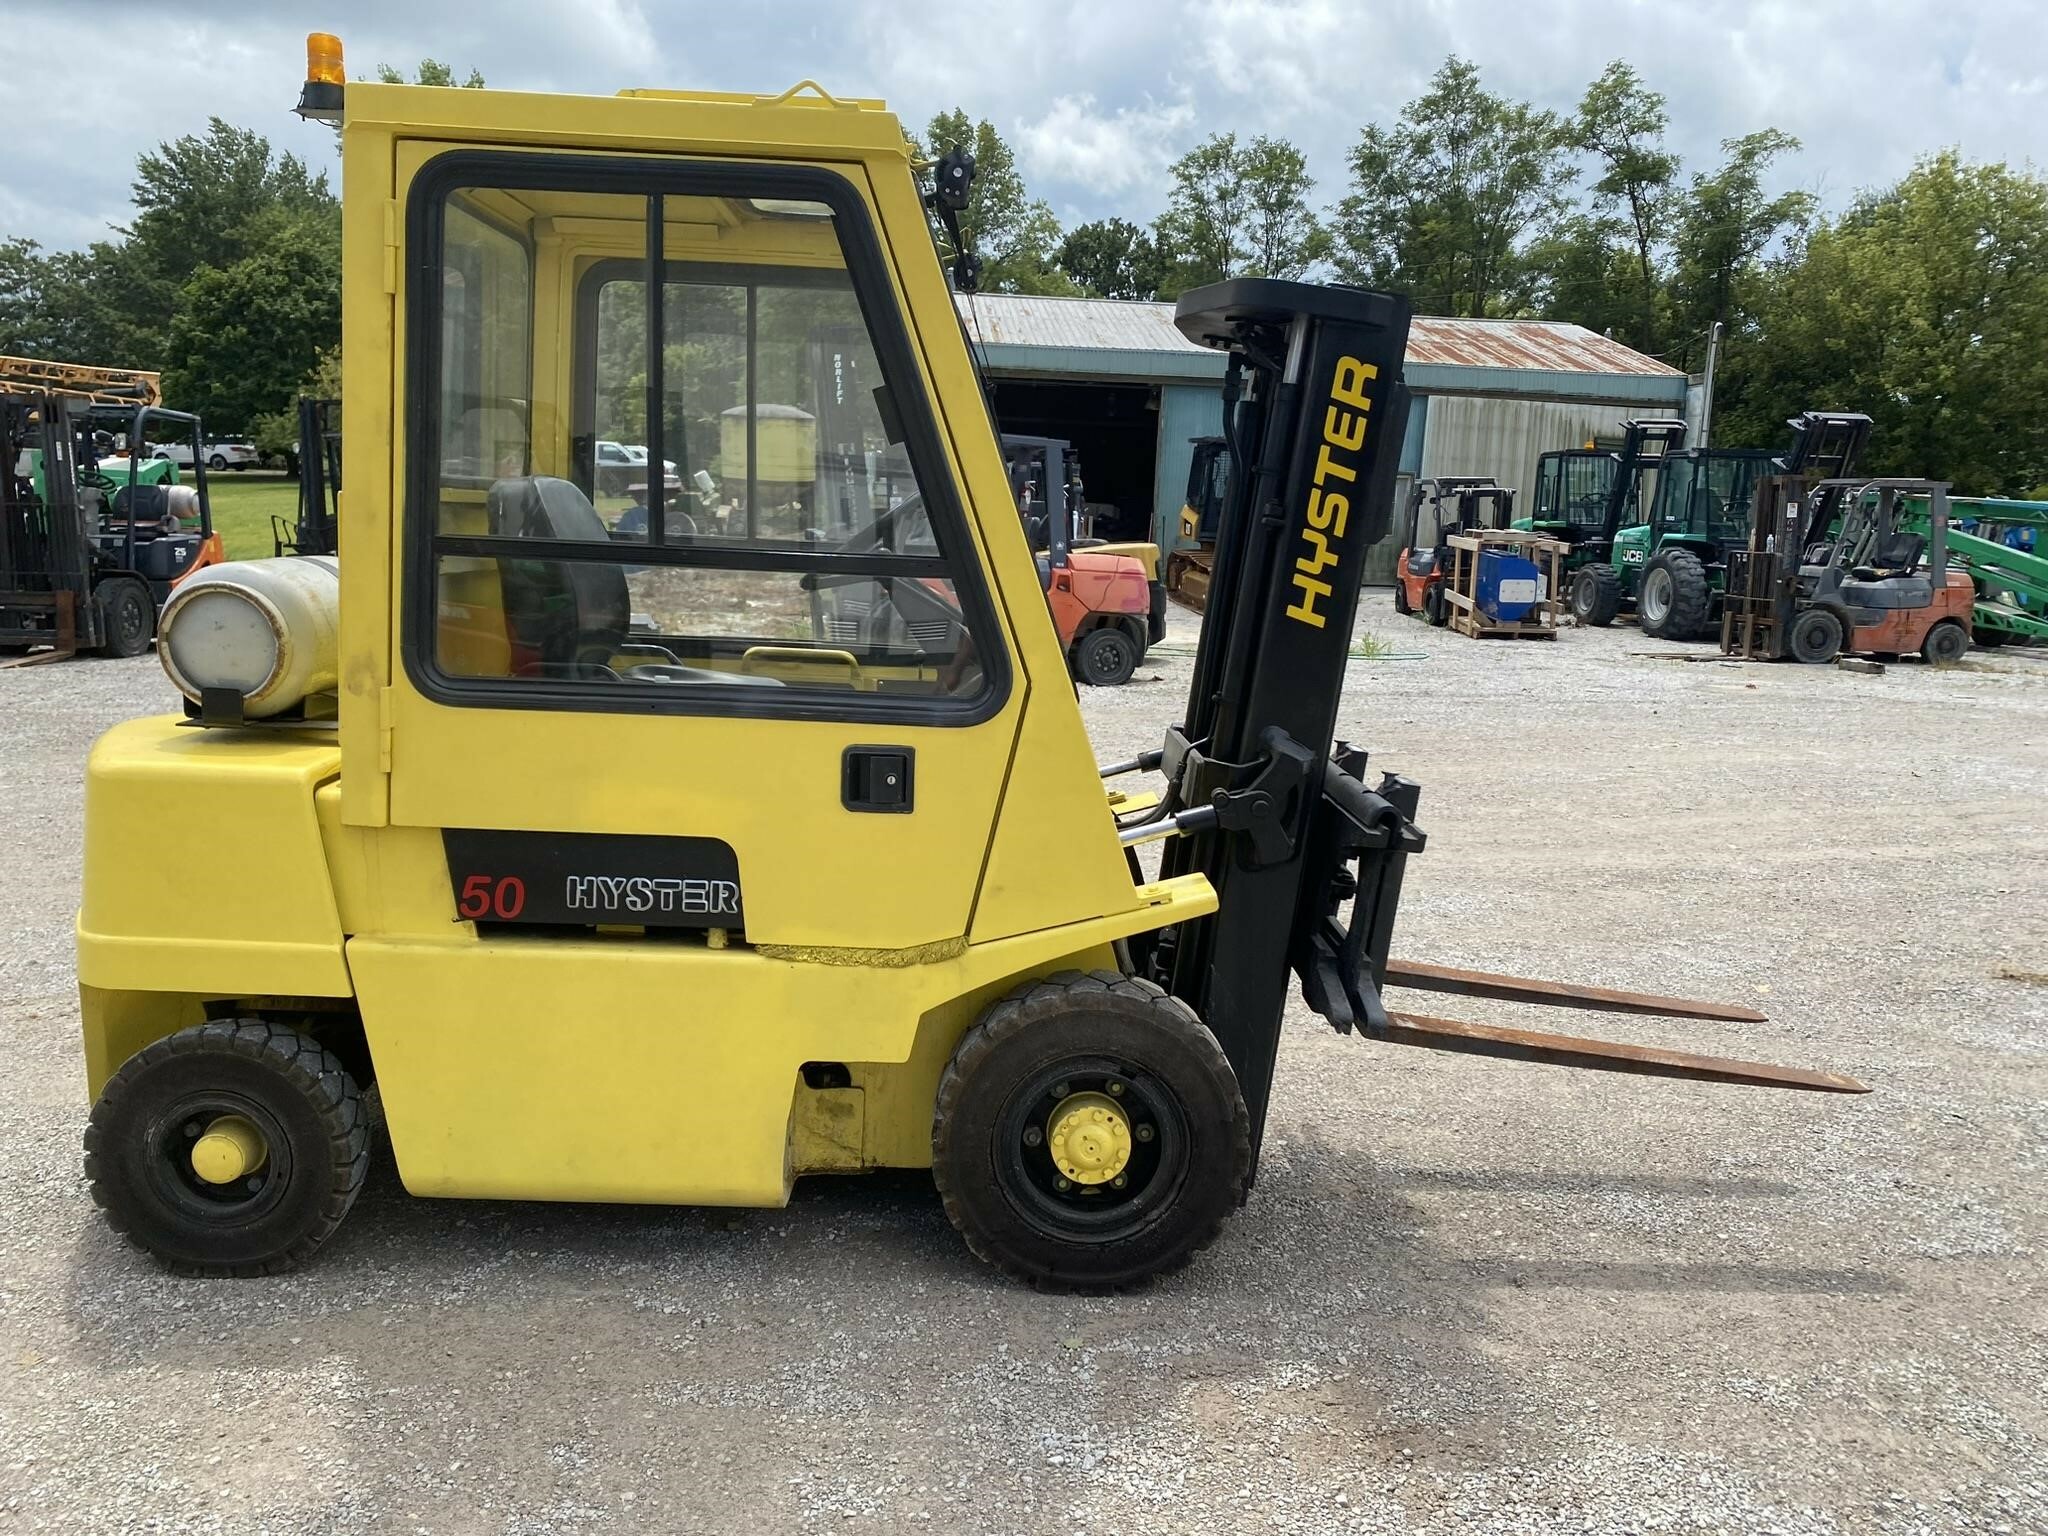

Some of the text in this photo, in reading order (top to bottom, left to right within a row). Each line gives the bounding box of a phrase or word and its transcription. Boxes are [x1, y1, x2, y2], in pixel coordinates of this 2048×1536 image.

[1286, 355, 1379, 629] HYSTER
[1622, 549, 1644, 563] JCB
[460, 875, 525, 919] 50
[567, 876, 740, 914] HYSTER
